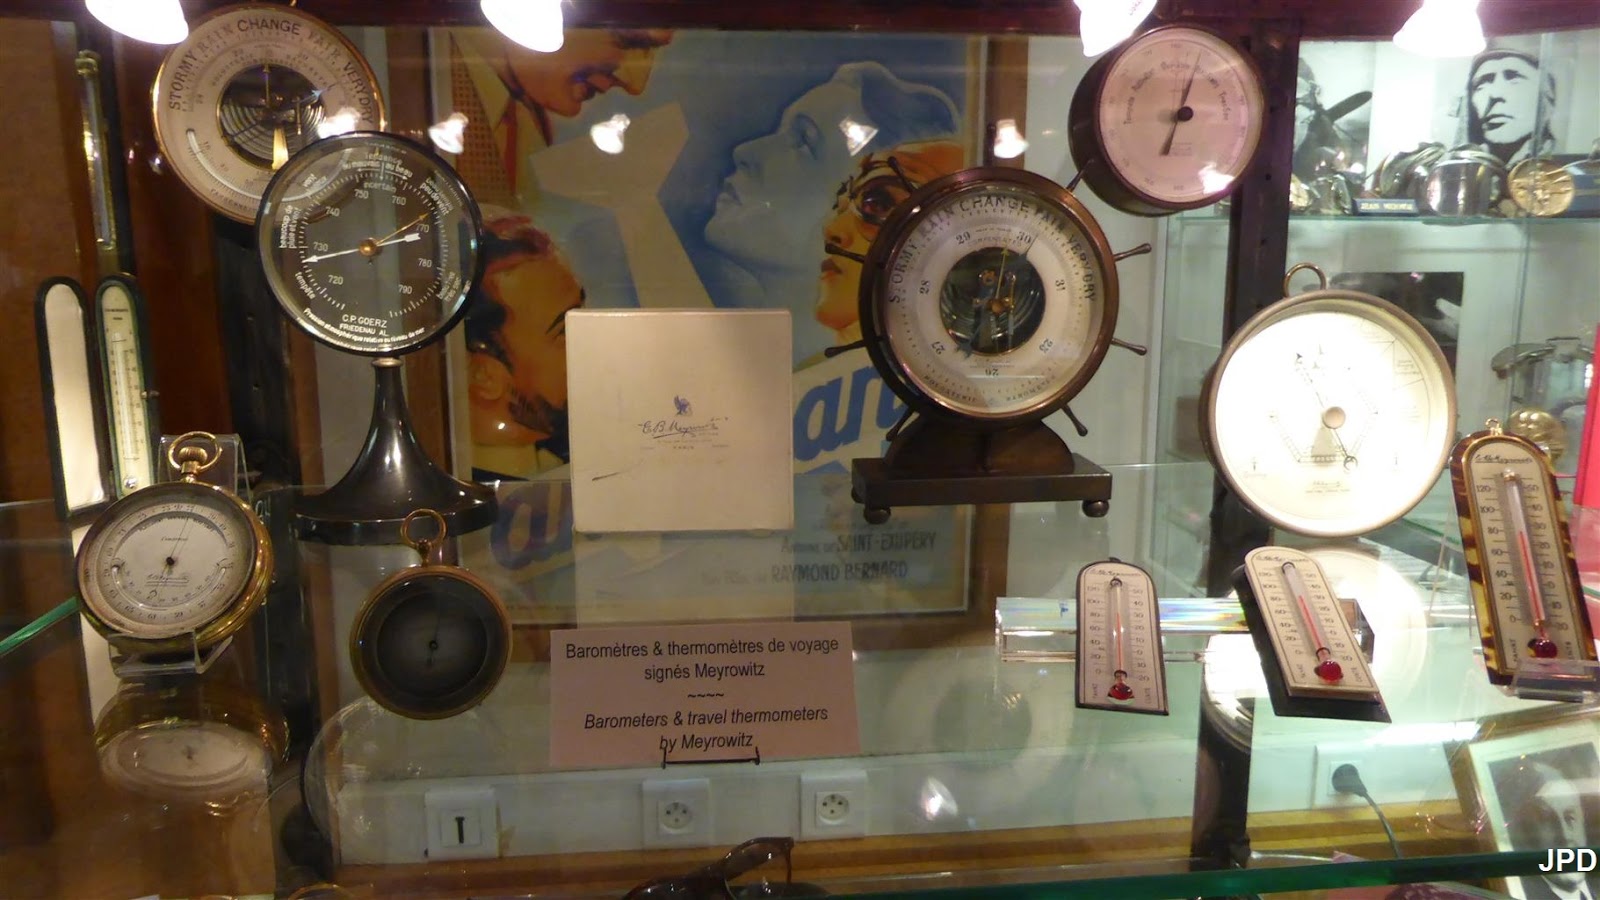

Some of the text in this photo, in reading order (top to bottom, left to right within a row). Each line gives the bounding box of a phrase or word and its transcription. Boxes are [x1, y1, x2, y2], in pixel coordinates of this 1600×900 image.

[168, 49, 198, 111] STORMY
[237, 18, 300, 36] CHANGE
[342, 61, 367, 95] VERY
[359, 97, 374, 124] DRY
[354, 188, 370, 200] 750
[391, 195, 407, 206] 760
[325, 206, 341, 217] 740
[959, 195, 1030, 214] CHANGE
[312, 241, 329, 252] 730
[418, 257, 433, 268] 780
[328, 274, 344, 286] 720
[398, 284, 413, 295] 790
[772, 562, 840, 581] RAYMOND
[844, 560, 908, 580] BERNARD
[566, 638, 839, 659] Baromètres & thermomètres de voyage
[644, 662, 765, 683] signés Meyrowitz
[584, 706, 828, 729] Barometers & travel thermometers
[659, 732, 753, 753] by Meyrowitz
